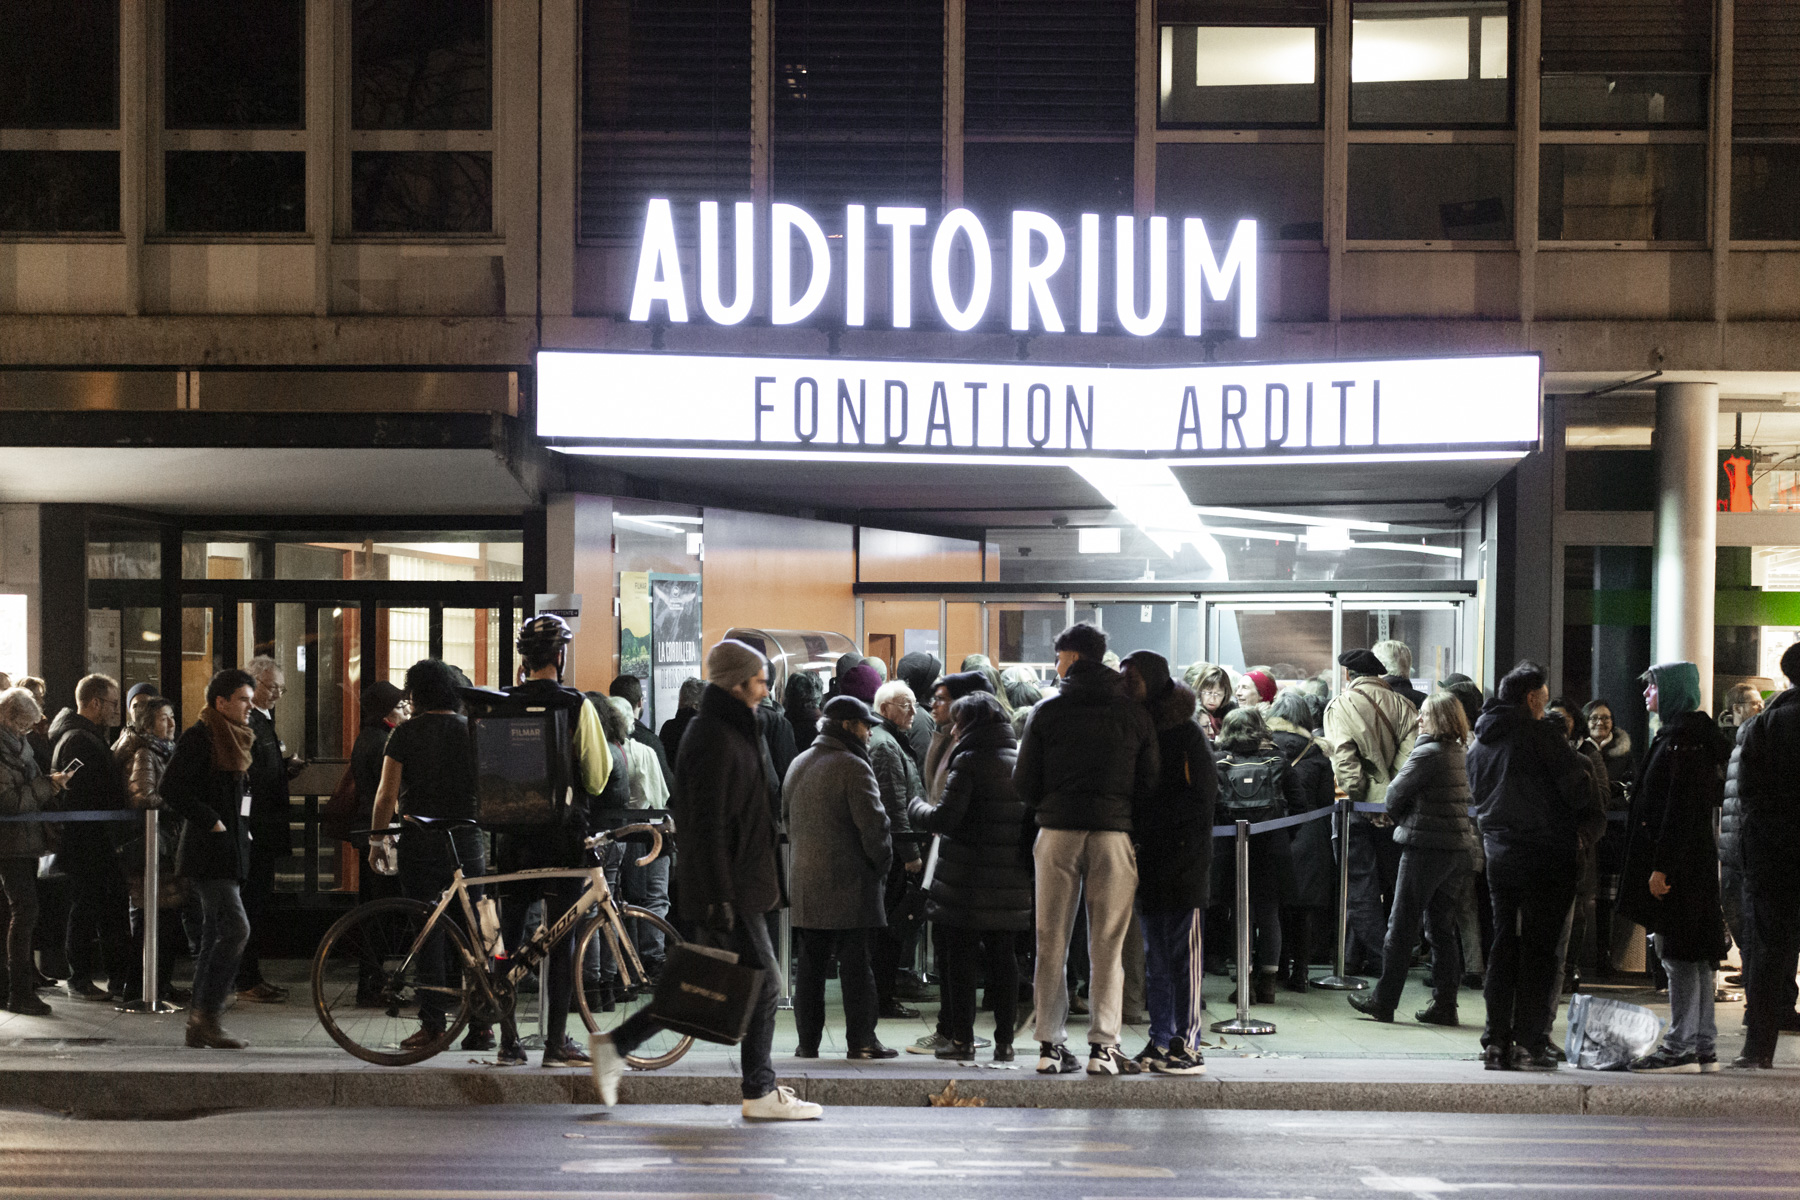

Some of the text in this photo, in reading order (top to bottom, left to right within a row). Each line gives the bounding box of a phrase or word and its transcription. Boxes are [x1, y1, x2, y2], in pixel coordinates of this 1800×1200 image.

[628, 198, 1258, 338] AUDITORIUM
[754, 376, 1380, 450] FONDATION ARDITI
[657, 640, 696, 663] LA CORDILLERA
[511, 729, 541, 737] FILMAR
